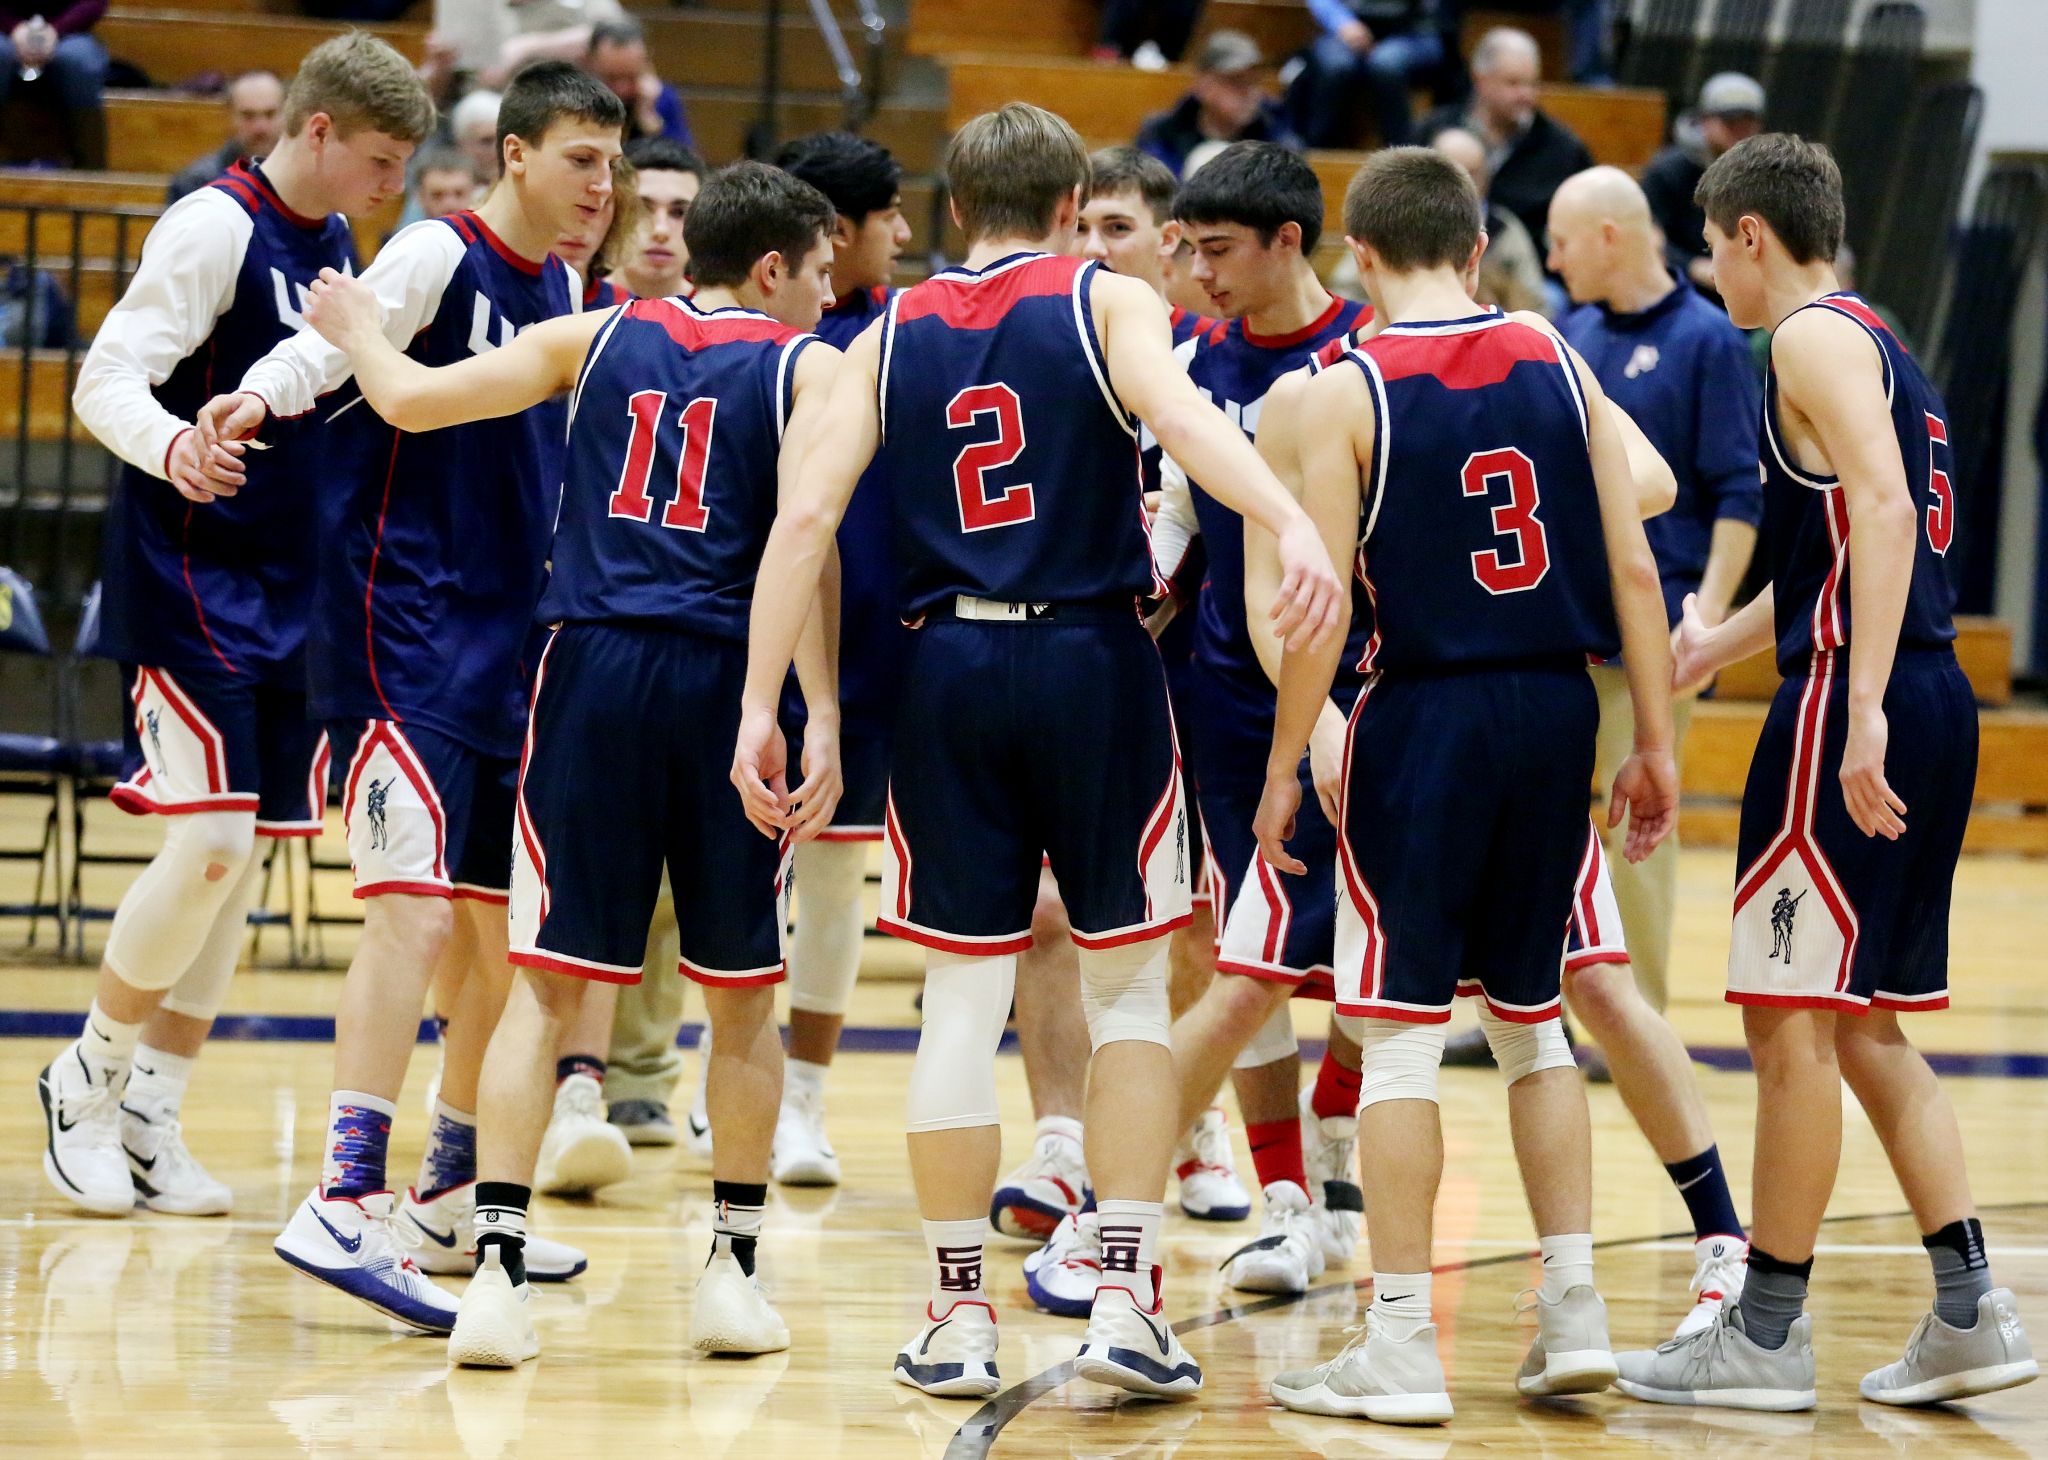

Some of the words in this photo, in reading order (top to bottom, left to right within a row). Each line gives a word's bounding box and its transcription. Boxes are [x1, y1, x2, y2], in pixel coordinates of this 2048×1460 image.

[608, 389, 718, 533] 11
[945, 381, 1036, 534] 2
[1460, 446, 1551, 596] 3
[1923, 408, 1955, 558] 5
